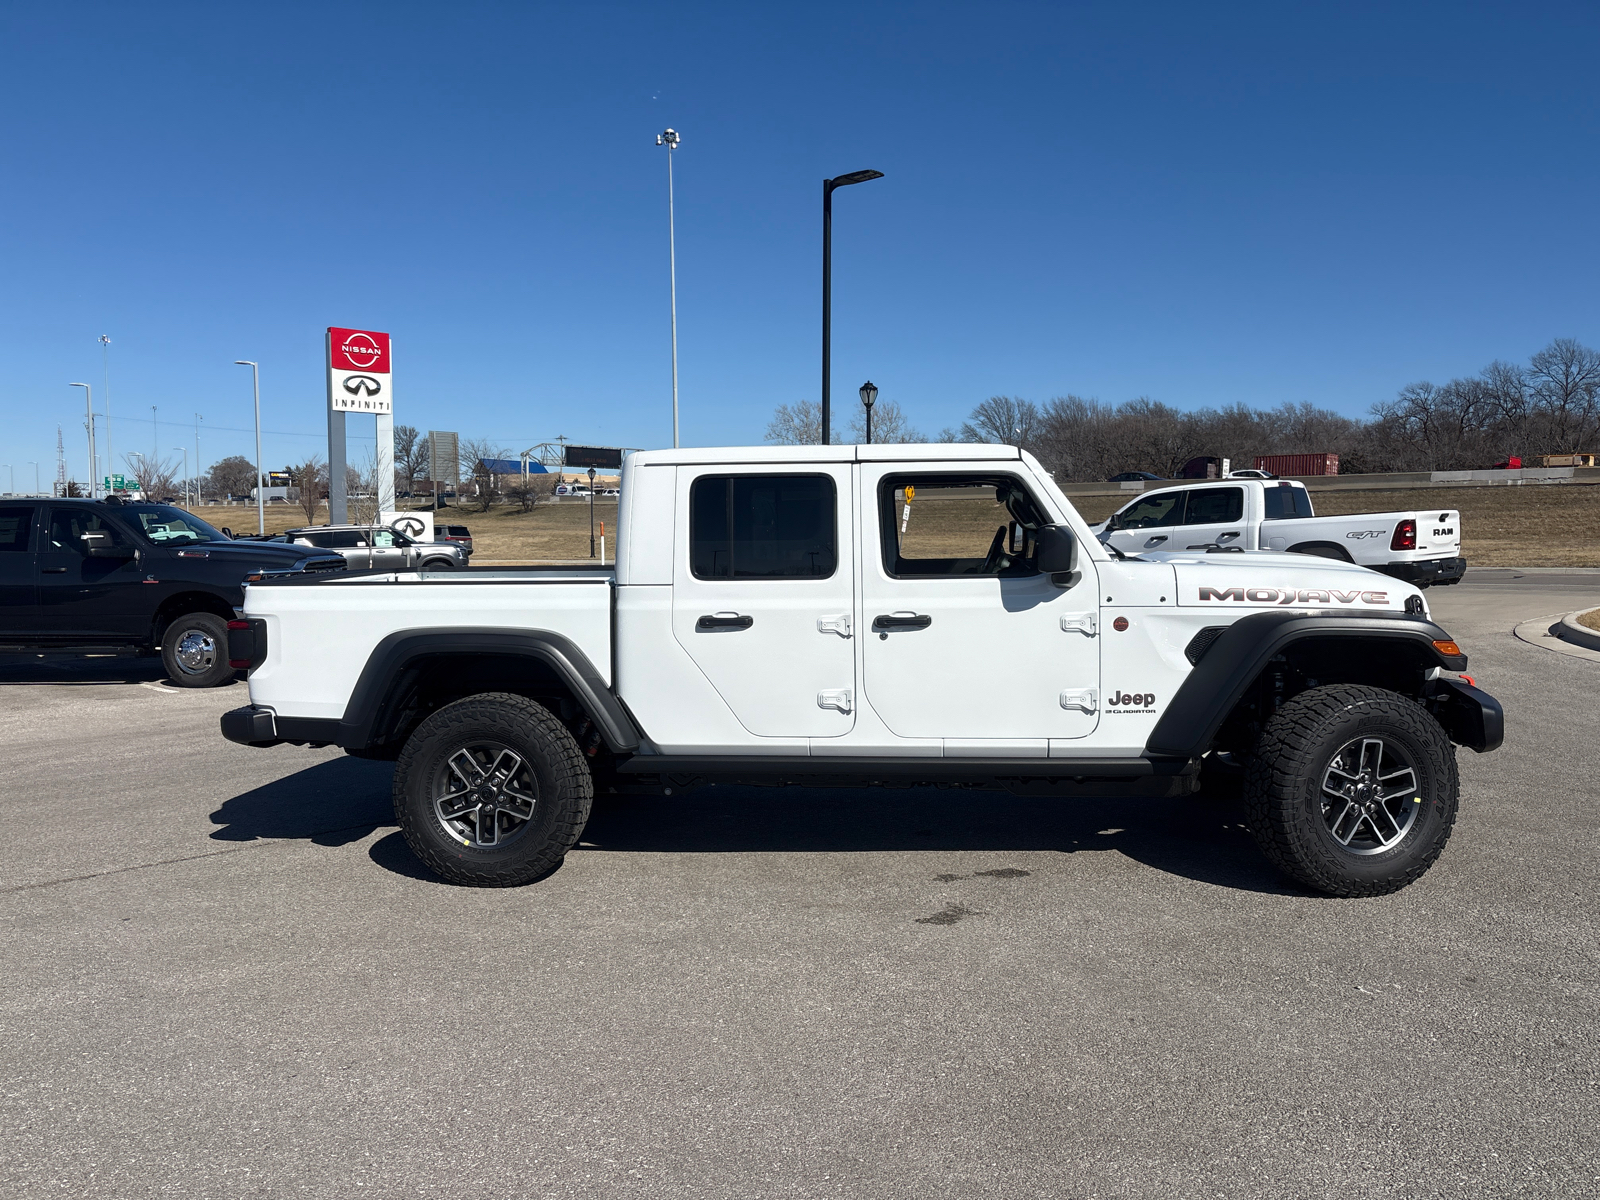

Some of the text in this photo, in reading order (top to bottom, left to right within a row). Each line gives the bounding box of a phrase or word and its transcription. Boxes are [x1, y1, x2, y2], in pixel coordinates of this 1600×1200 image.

[342, 345, 381, 355] NISSAN
[335, 399, 390, 410] INFINITI
[1433, 528, 1453, 536] RAM
[1198, 587, 1390, 605] MOJAVE
[1108, 690, 1155, 708] Jeep
